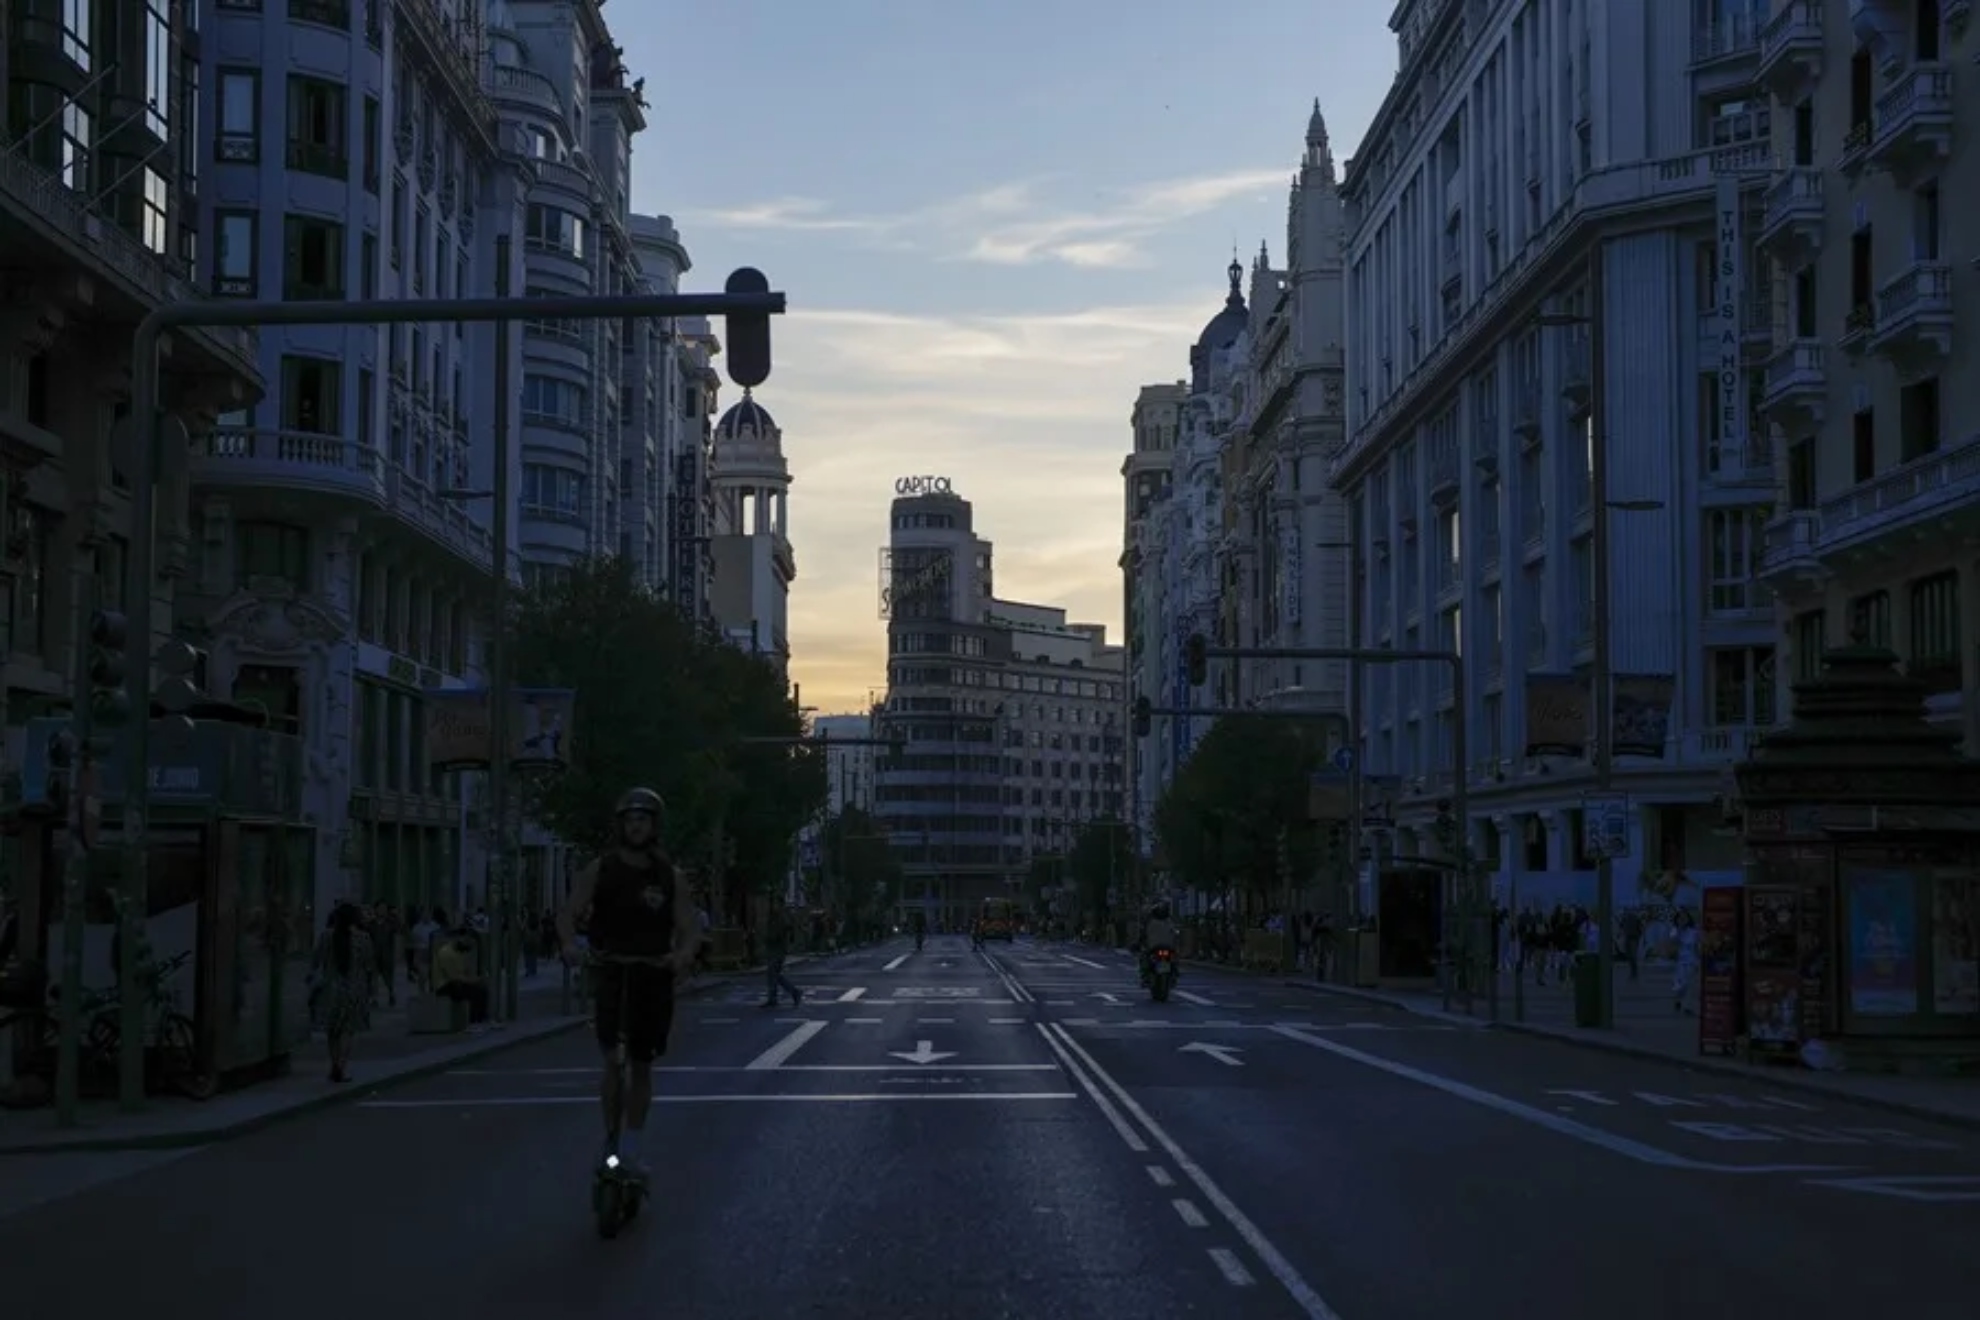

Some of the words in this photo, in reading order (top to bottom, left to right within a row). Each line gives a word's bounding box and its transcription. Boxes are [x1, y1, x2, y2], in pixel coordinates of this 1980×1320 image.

[1722, 211, 1735, 275] THIS
[1722, 285, 1735, 318] IS
[1722, 330, 1735, 344] A
[1722, 354, 1735, 438] HOTEL
[895, 475, 952, 494] CAPITOL
